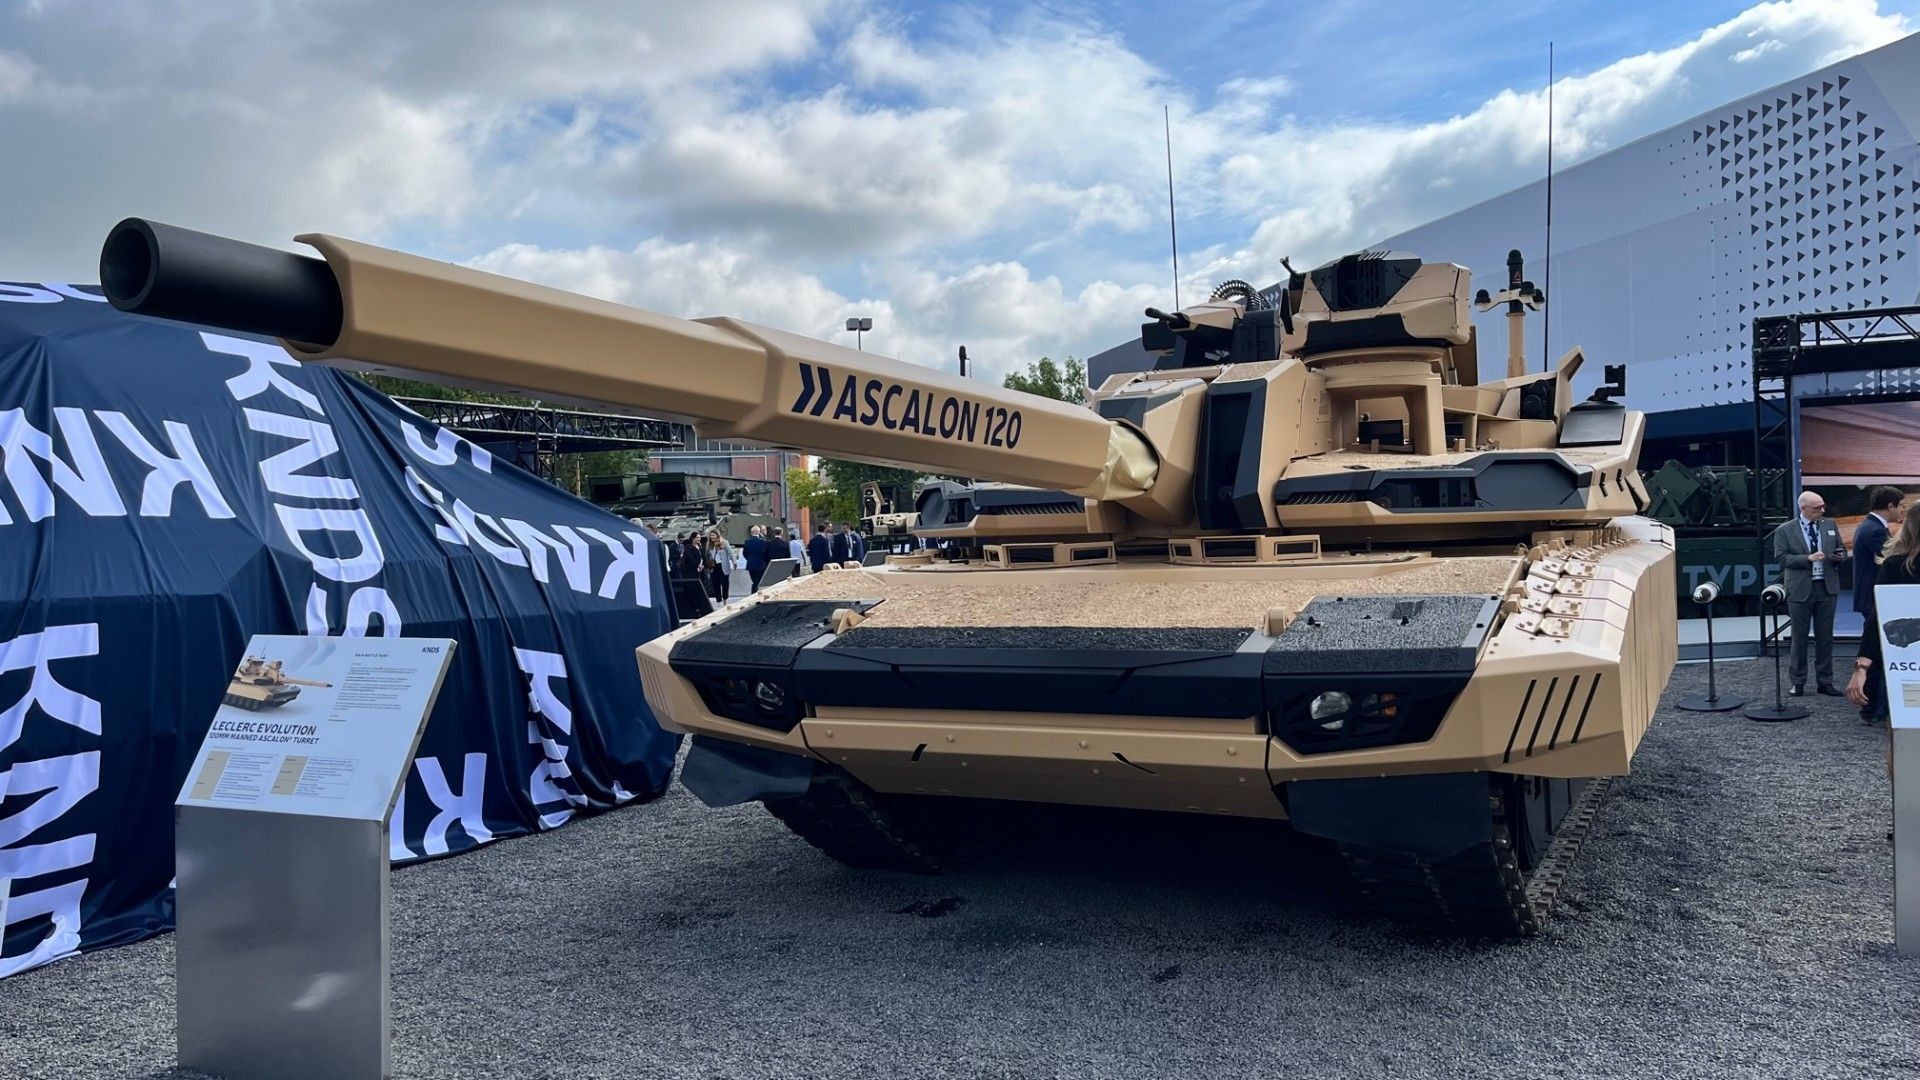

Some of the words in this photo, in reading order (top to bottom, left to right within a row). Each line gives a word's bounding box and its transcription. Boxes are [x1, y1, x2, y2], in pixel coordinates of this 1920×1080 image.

[832, 374, 980, 443] ASCALON
[983, 406, 1022, 449] 120
[0, 406, 237, 526] KN
[1888, 662, 1920, 672] ASC
[212, 720, 257, 733] LECLERC
[256, 723, 317, 736] EVOLUTION
[230, 732, 258, 741] MANNED
[293, 736, 319, 744] TURRET
